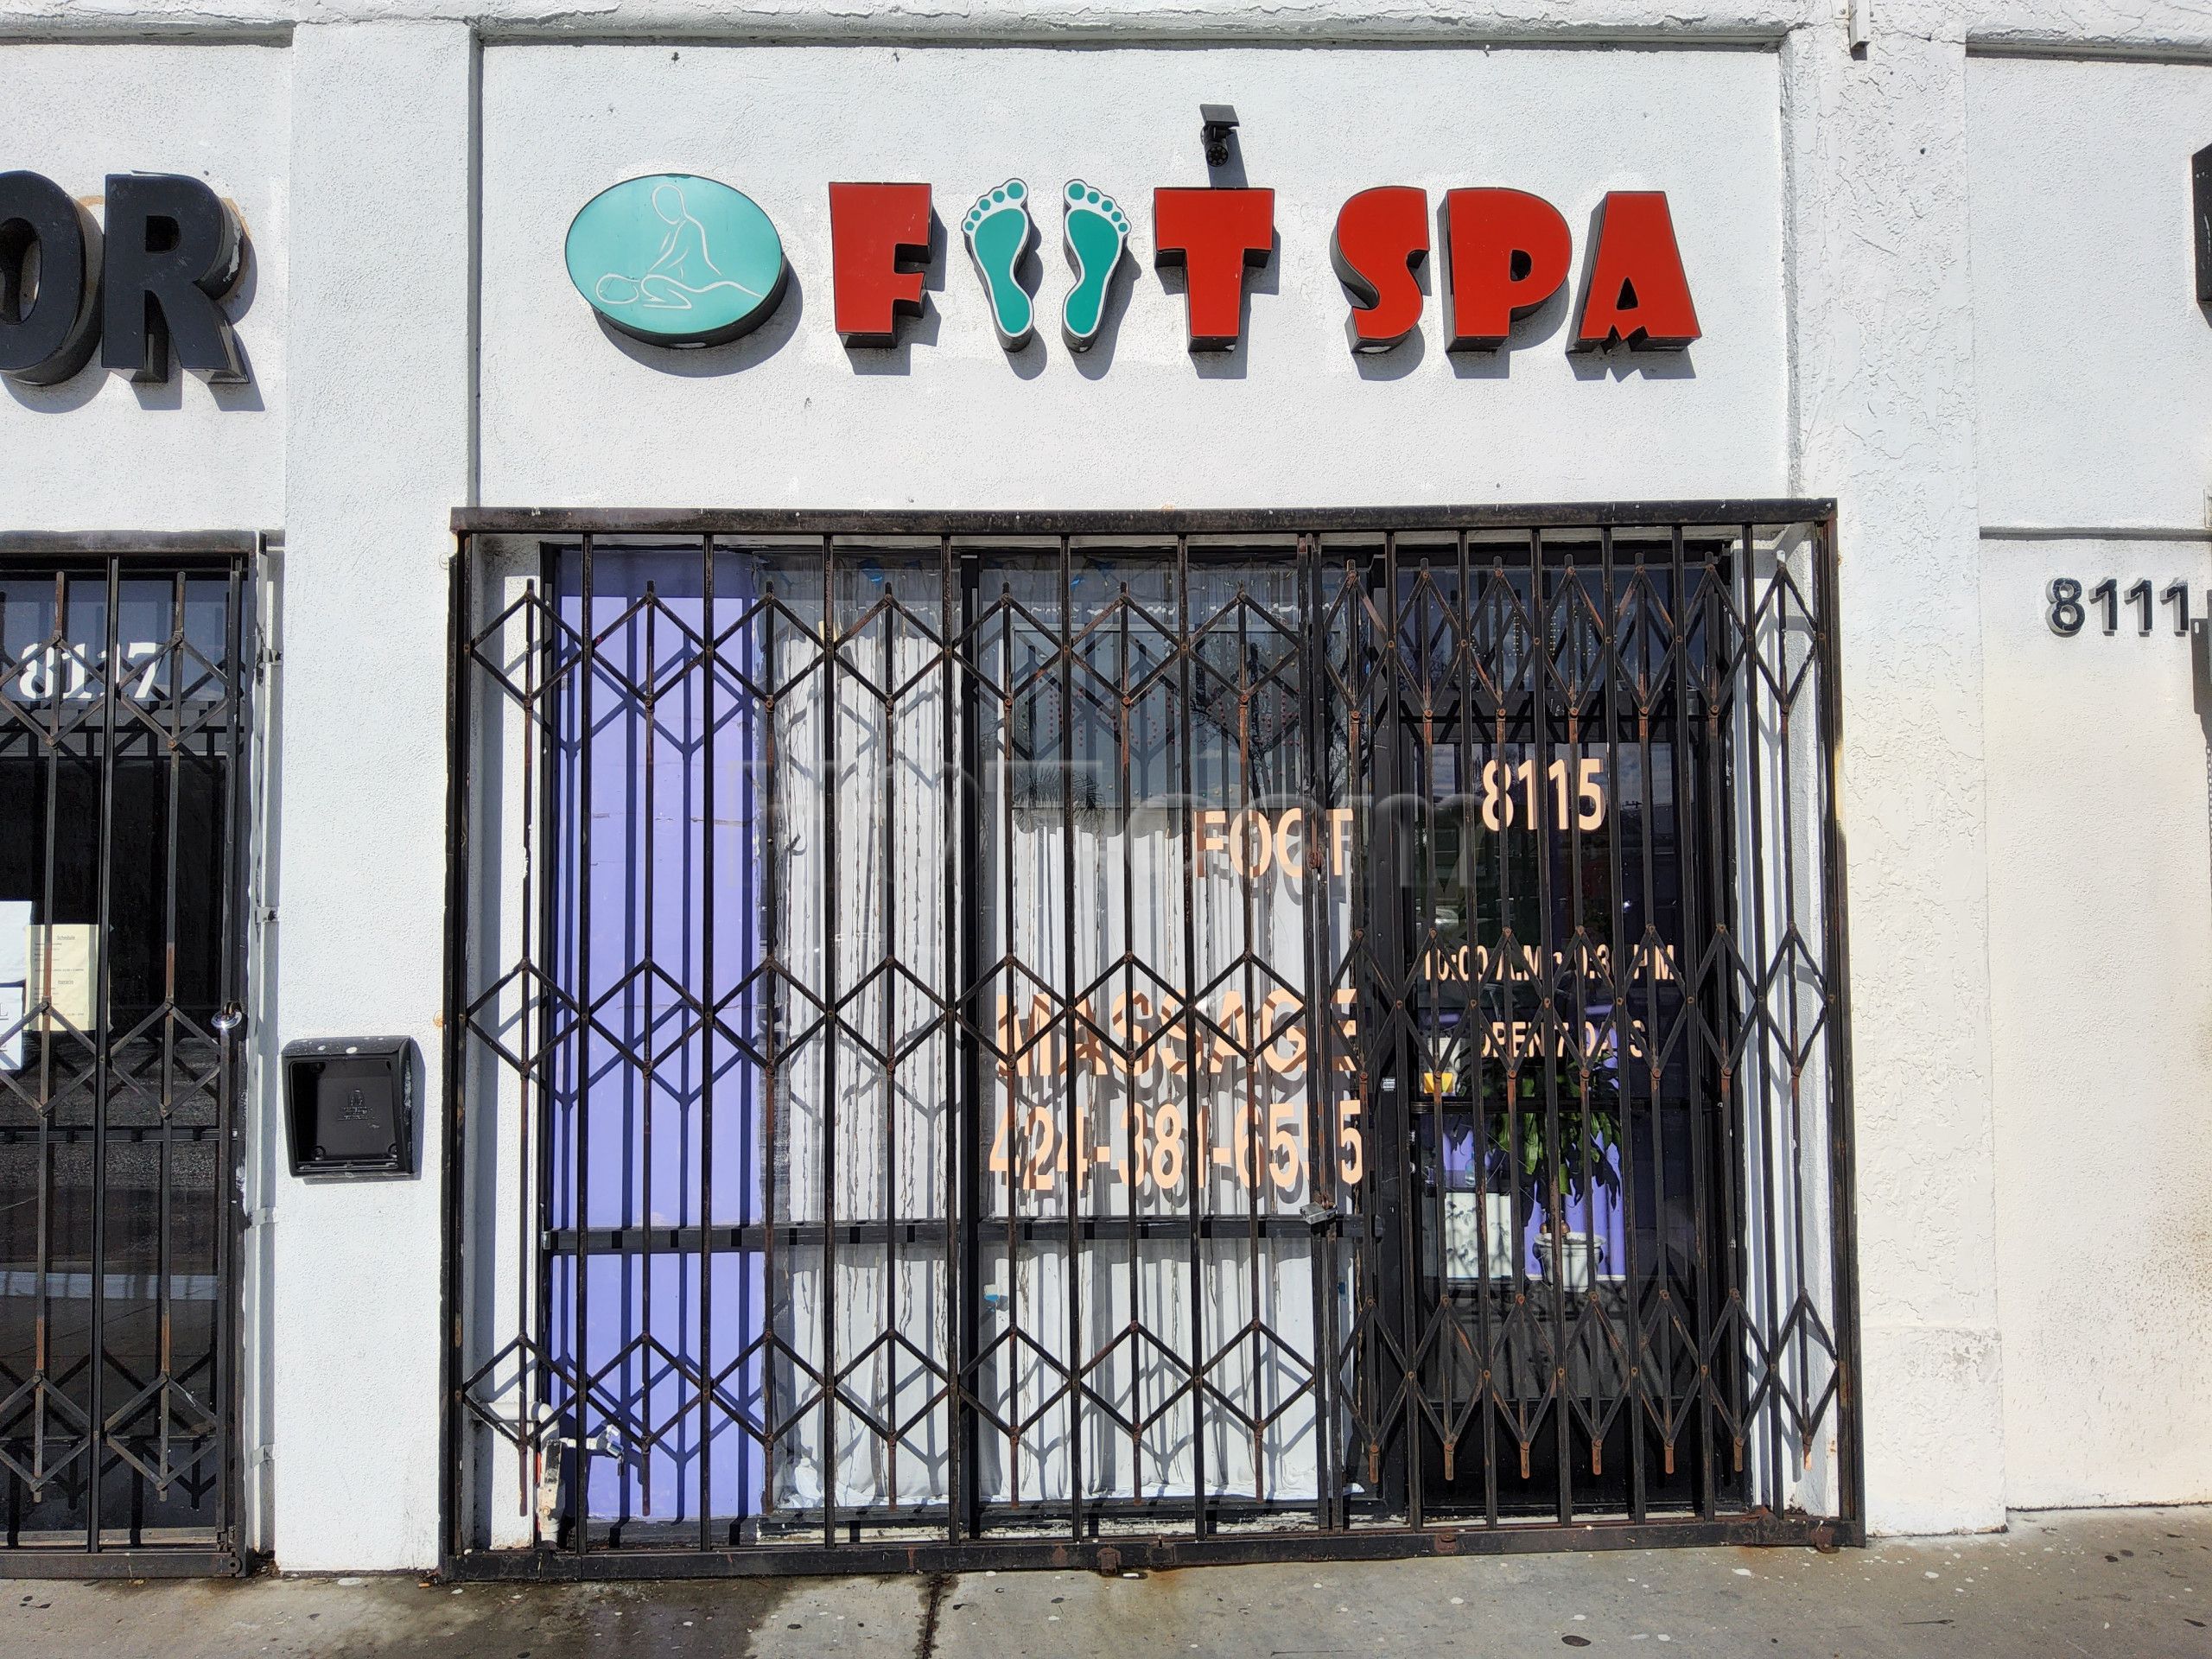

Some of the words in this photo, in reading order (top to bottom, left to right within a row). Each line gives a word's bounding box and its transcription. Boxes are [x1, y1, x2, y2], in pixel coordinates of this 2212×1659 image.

[1330, 185, 1702, 353] SPA
[2045, 577, 2189, 638] 8111
[1482, 759, 1606, 831] 8115
[997, 988, 1357, 1077] MASSAGE
[1584, 1020, 1647, 1058] DAS
